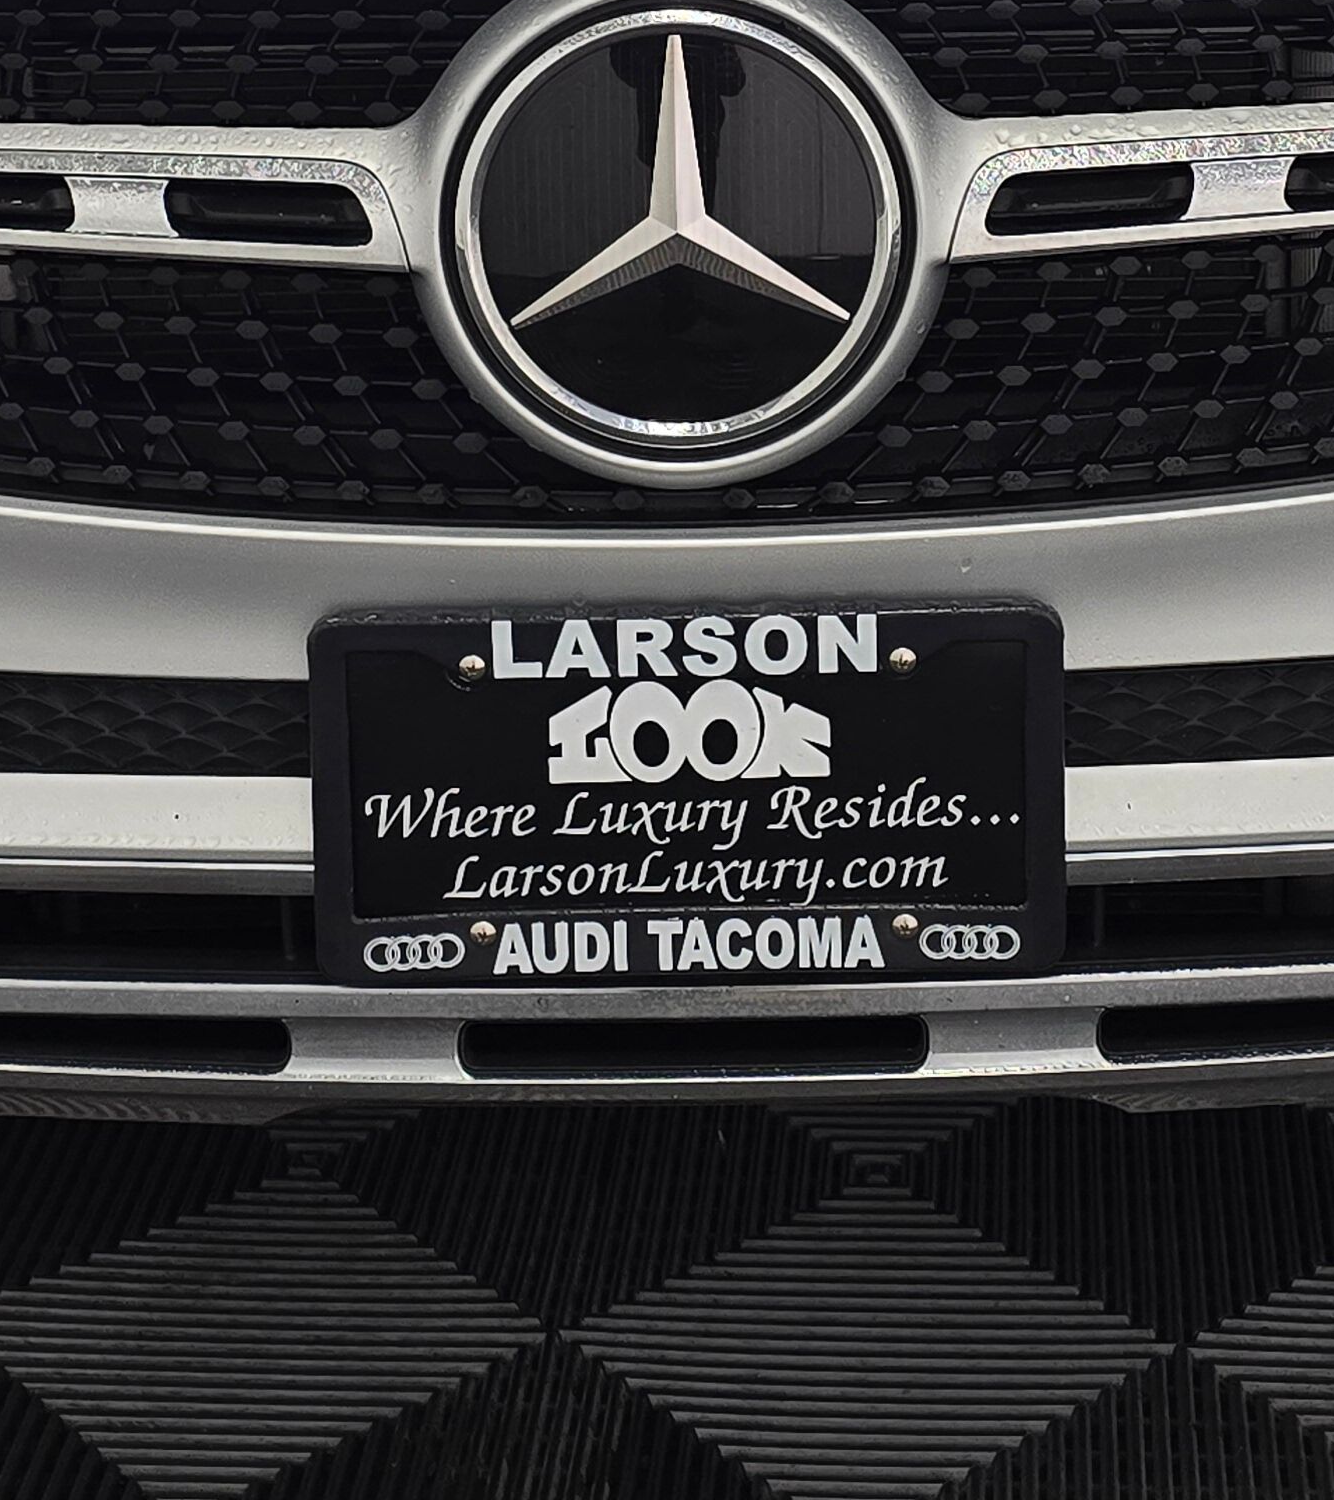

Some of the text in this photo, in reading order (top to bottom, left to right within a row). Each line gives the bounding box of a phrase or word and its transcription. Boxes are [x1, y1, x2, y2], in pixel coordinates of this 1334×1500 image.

[491, 613, 879, 680] LARSON
[364, 777, 1021, 850] Where Luxury Resides...
[442, 849, 948, 906] LarsonLuxury.com
[492, 914, 886, 976] AUDI TACOMA
